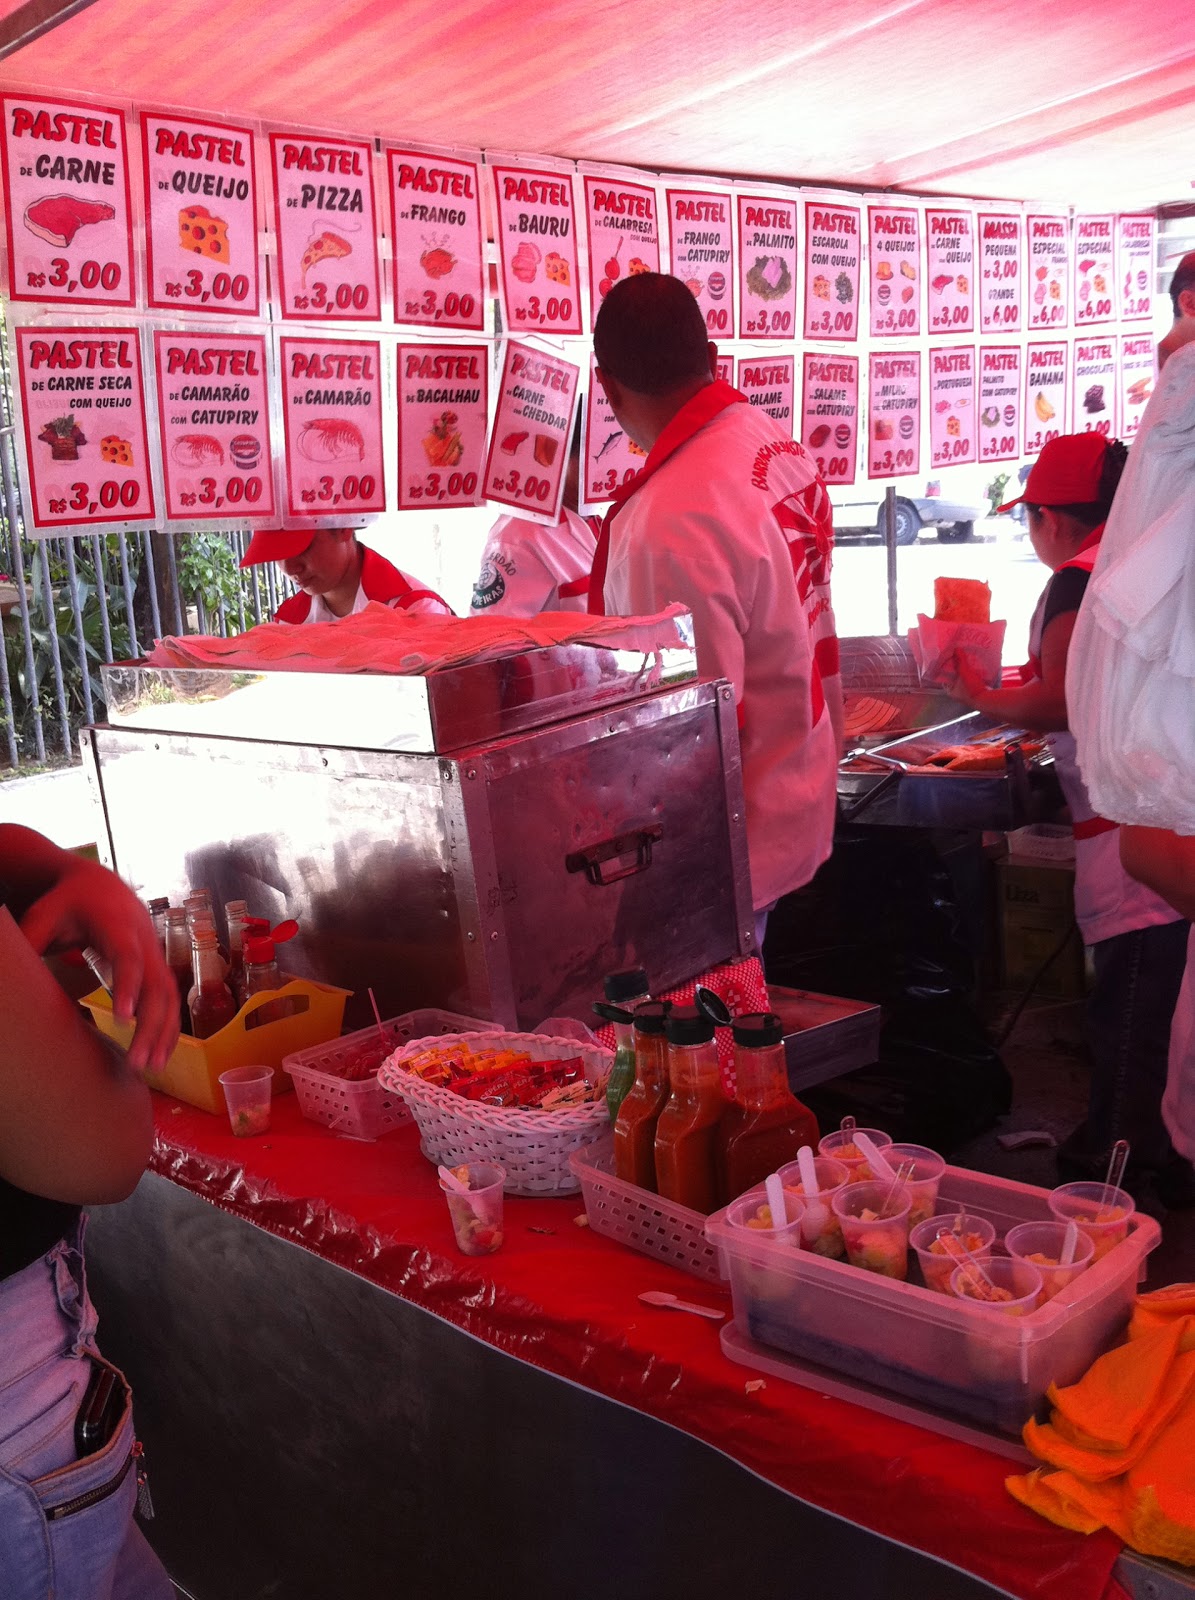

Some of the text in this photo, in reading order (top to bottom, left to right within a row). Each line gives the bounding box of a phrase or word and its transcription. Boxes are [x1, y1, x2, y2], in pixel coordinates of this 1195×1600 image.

[12, 108, 117, 149] PASTEL
[155, 128, 246, 167] PASTEL
[20, 154, 115, 185] DE CARNE
[282, 144, 363, 176] PASTEL
[158, 170, 249, 201] DE QUEIJO
[398, 164, 474, 199] PASTEL
[287, 184, 363, 213] DE PIZZA
[503, 177, 569, 207] PASTEL
[593, 188, 653, 219] PASTEL
[675, 200, 726, 223] PASTEL
[401, 204, 466, 226] DE FRANGO
[509, 213, 570, 237] DE BAURU
[594, 215, 654, 234] DE CALABRESA
[745, 207, 792, 229] PASTEL
[812, 211, 857, 235] PASTEL
[874, 215, 916, 235] PASTEL
[931, 217, 969, 235] PASTEL
[983, 221, 1018, 239] MASSA
[1033, 222, 1064, 237] PASTEL
[1078, 222, 1110, 237] PASTEL
[1122, 222, 1150, 237] PASTEL
[684, 232, 721, 246] FRANGO
[753, 233, 795, 249] PALMITO
[812, 236, 849, 250] ESCAROLA
[877, 240, 915, 252] 4 QUEIJOS
[936, 238, 960, 249] CARNE
[1033, 242, 1065, 254] ESPECIAL
[1078, 242, 1111, 255] ESPECIAL
[687, 249, 730, 264] CATUPIRY
[946, 252, 972, 263] QUEIJO
[985, 244, 1017, 256] PEQUENA
[811, 253, 857, 268] COM QUEIJO
[992, 260, 1018, 281] 3,00
[27, 258, 121, 293] R$ 3,00
[165, 269, 249, 302] R$ 3,00
[294, 282, 369, 313] R$ 3,00
[988, 289, 1015, 300] GRANDE
[405, 290, 475, 320] R$ 3,00
[515, 296, 572, 323] R$ 3,00
[993, 305, 1018, 325] 6,00
[1040, 305, 1065, 325] 6,00
[1085, 299, 1112, 319] 6,00
[757, 310, 791, 334] 3,00
[821, 311, 854, 334] 3,00
[885, 309, 916, 331] 3,00
[940, 306, 969, 327] 3,00
[30, 340, 133, 370] PASTEL
[166, 347, 259, 377] PASTEL
[934, 354, 971, 373] PASTEL
[983, 354, 1018, 371] PASTEL
[1030, 351, 1064, 367] PASTEL
[1077, 345, 1112, 362] PASTEL
[291, 352, 374, 380] PASTEL
[405, 354, 480, 380] PASTEL
[510, 353, 570, 394] PASTEL
[743, 364, 790, 388] PASTEL
[808, 361, 854, 383] PASTEL
[874, 360, 917, 379] PASTEL
[1077, 363, 1114, 376] CHOCOLATE
[32, 376, 132, 391] DE CARNE SECA
[936, 377, 973, 389] PORTUGUESA
[1029, 371, 1064, 386] BANANA
[169, 385, 250, 402] DE CAMARÃO
[293, 388, 372, 406] DE CAMARÃO
[406, 389, 480, 404] DE BACALHAU
[512, 385, 546, 406] CARNE
[749, 391, 783, 406] SALAME
[814, 388, 847, 401] SALAME
[881, 385, 906, 396] MILHO
[69, 397, 132, 409] COM QUEIJO
[763, 406, 790, 420] UEIJO
[816, 404, 855, 417] CATUPIRY
[881, 397, 918, 411] CATUPIRY
[170, 409, 259, 425] COM CATUPIRY
[522, 404, 567, 431] CHEDDAR
[941, 439, 970, 461] 3,00
[990, 436, 1015, 457] 3,00
[882, 448, 915, 472] 3,00
[180, 476, 262, 508] R$ 3,00
[301, 475, 376, 505] R$ 3,00
[409, 472, 478, 500] R$ 3,00
[493, 469, 551, 501] R$ 3,00
[592, 481, 603, 493] R$
[50, 480, 140, 514] R$ 3,00
